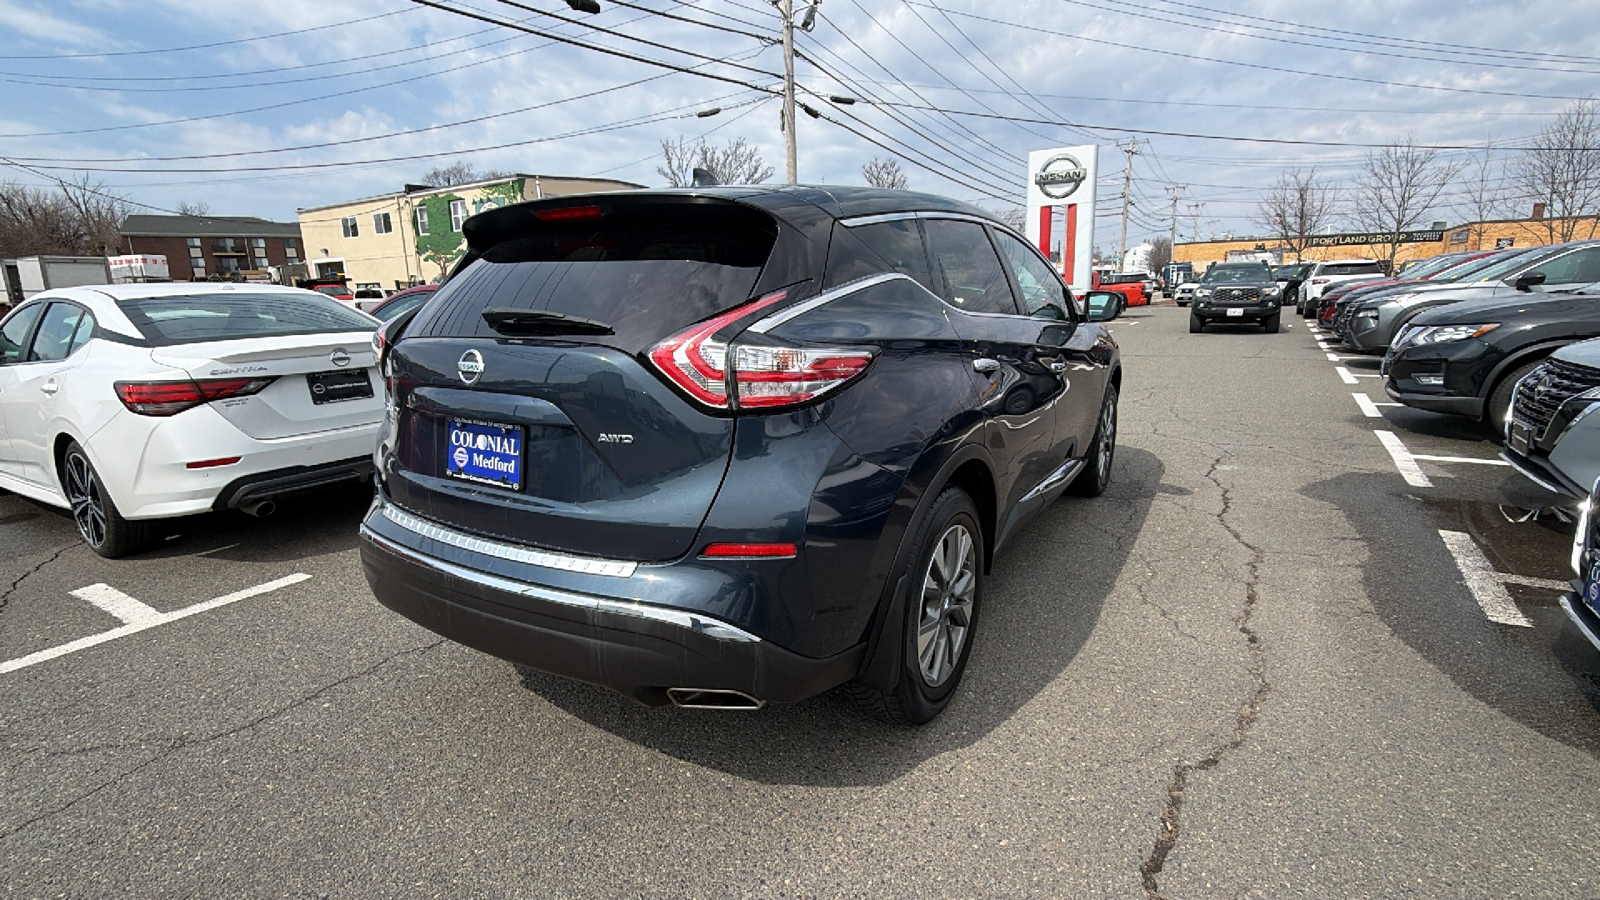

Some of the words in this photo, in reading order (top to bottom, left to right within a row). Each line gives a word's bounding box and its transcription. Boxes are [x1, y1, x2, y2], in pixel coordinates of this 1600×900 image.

[1039, 171, 1081, 181] NISSAN
[1312, 236, 1367, 246] PORTLAND
[210, 366, 268, 375] SENTRA
[451, 429, 519, 456] COLONIAL
[597, 433, 634, 444] AWD
[472, 453, 516, 474] Medford
